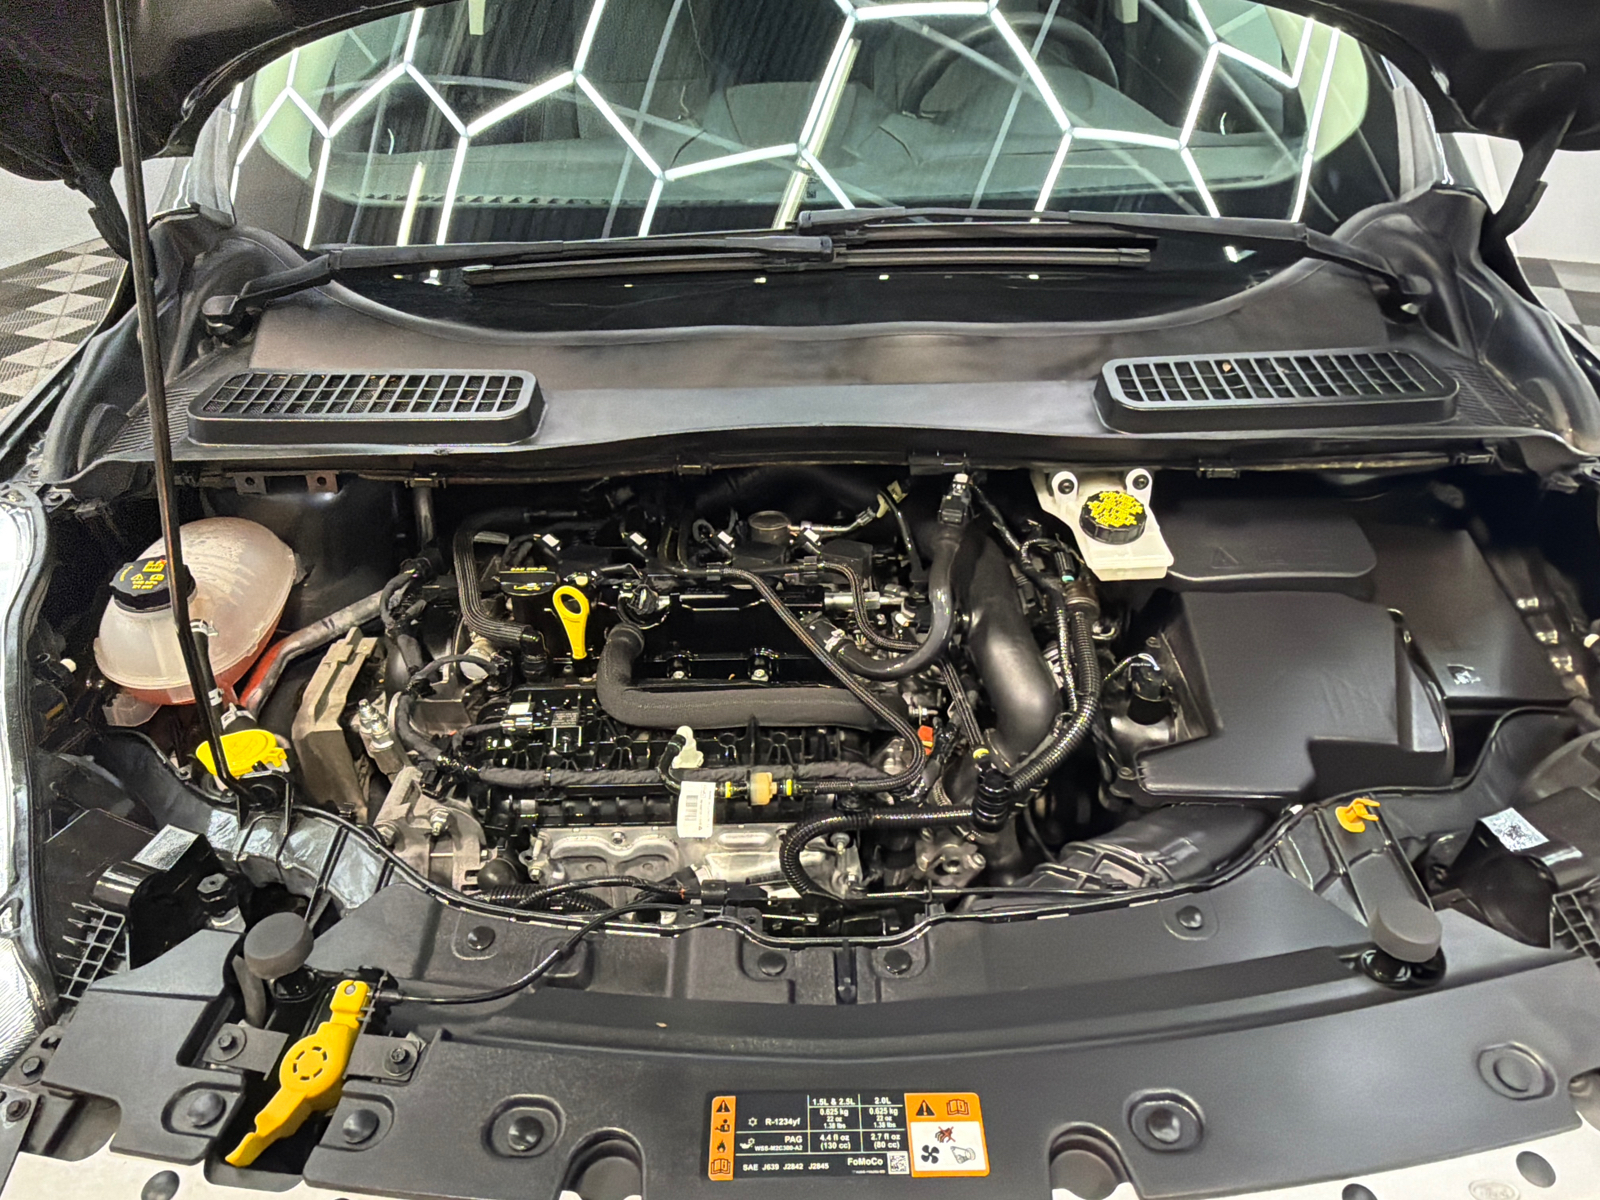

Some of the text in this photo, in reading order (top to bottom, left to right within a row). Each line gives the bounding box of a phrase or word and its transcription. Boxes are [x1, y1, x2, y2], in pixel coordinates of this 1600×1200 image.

[812, 1097, 856, 1106] 1.5L & 2.5L
[874, 1096, 891, 1105] 2.0L
[819, 1108, 849, 1117] 0.625 kg
[868, 1107, 898, 1116] 0.625 kg
[765, 1117, 801, 1127] R-1234yf
[784, 1135, 803, 1144] PAG
[819, 1133, 832, 1141] 4.4
[833, 1133, 839, 1141] fl
[870, 1133, 882, 1141] 2.7
[883, 1132, 890, 1140] fl
[820, 1142, 851, 1151] (130 cc)
[873, 1141, 900, 1150] (80 cc)
[847, 1157, 884, 1166] FoMoCo
[742, 1163, 759, 1171] SAE
[761, 1163, 780, 1171] J639
[782, 1162, 804, 1170] J2842
